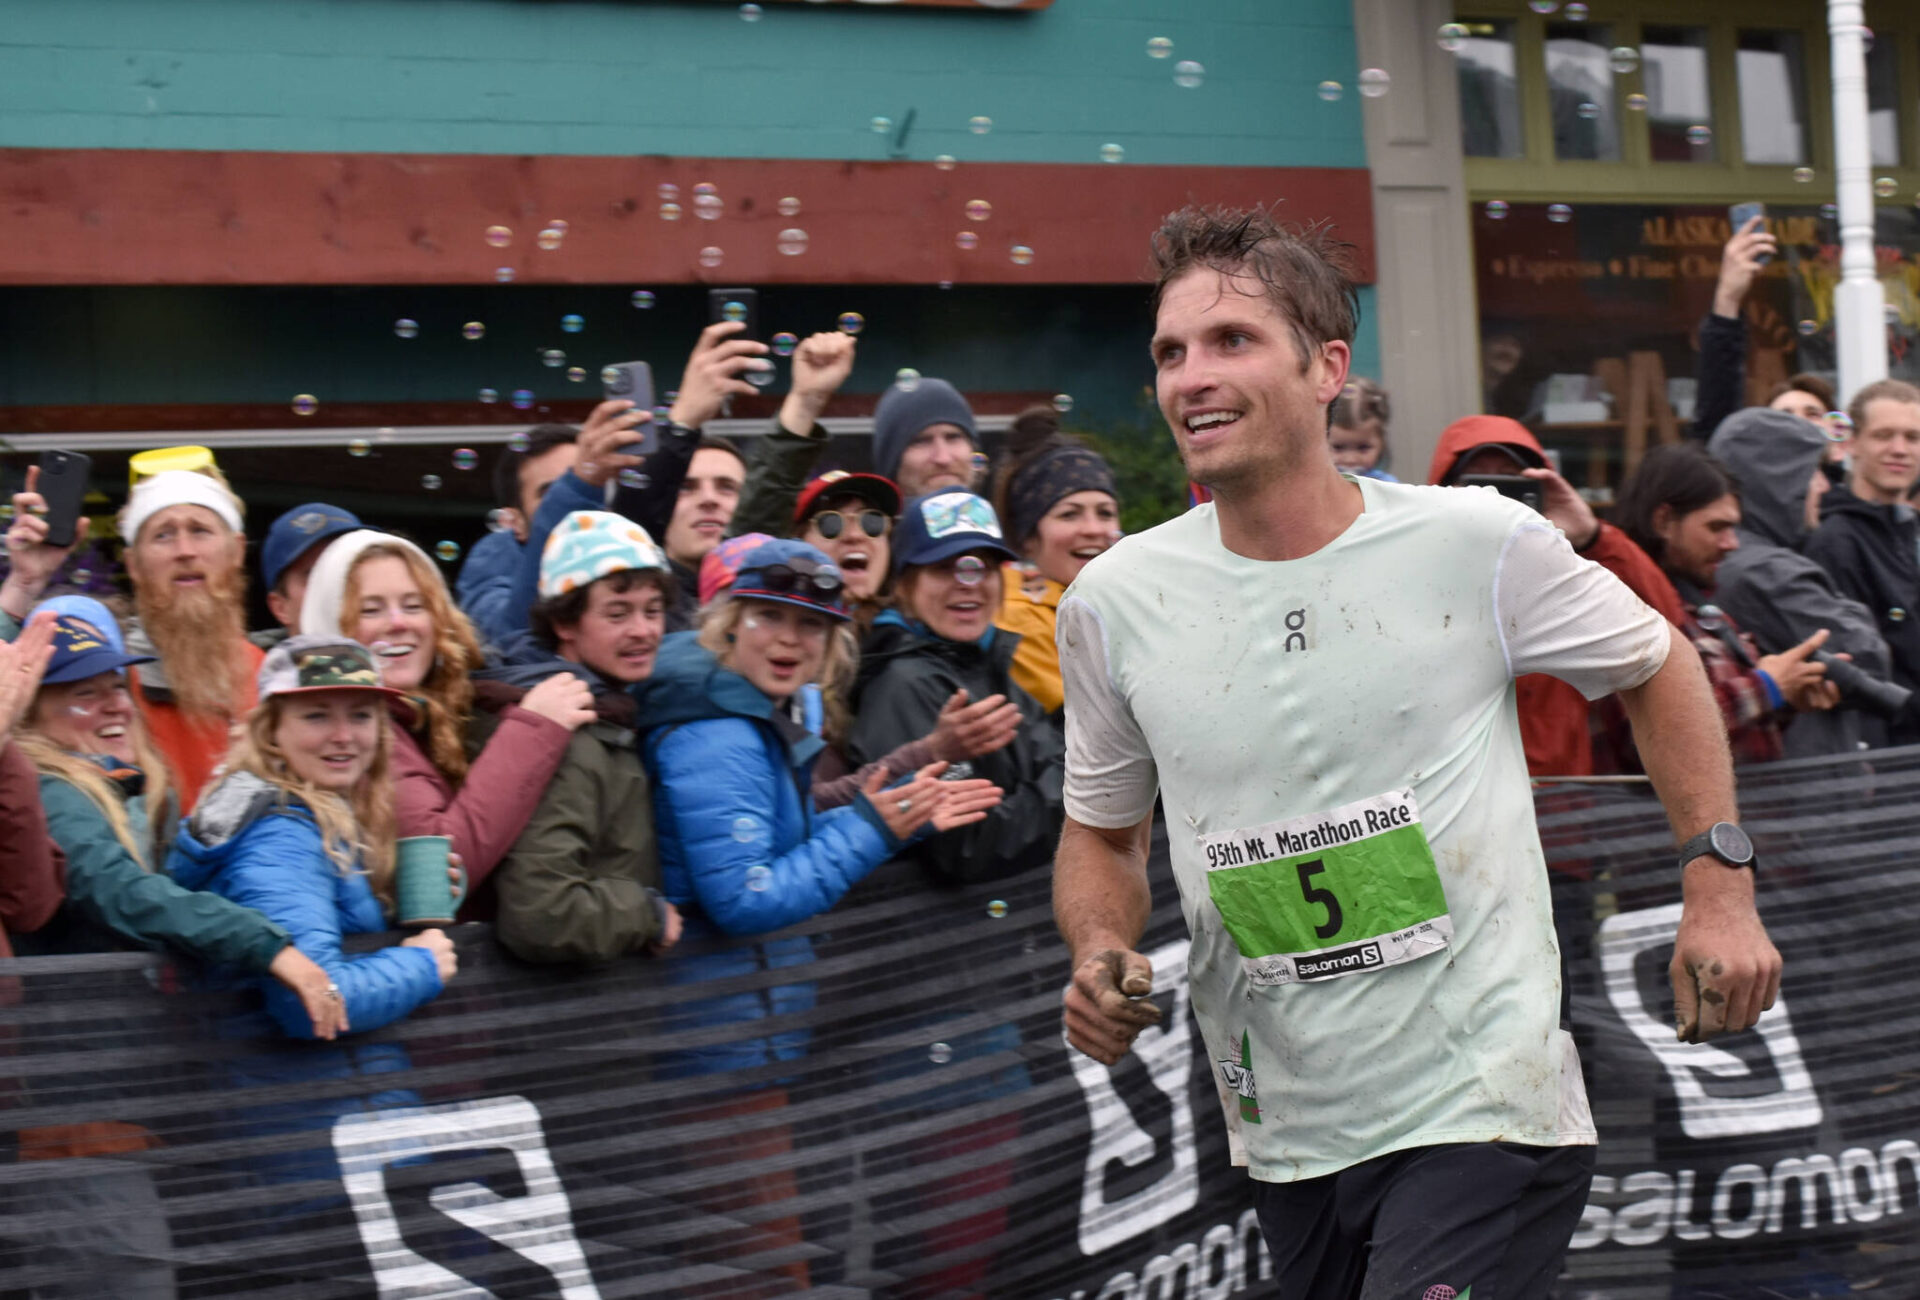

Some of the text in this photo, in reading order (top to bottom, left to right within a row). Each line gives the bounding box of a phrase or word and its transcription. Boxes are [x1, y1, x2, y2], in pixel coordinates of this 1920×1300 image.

[1207, 804, 1411, 868] 95th Mt. Marathon Race
[1296, 859, 1343, 939] 5
[1299, 954, 1360, 974] salomon
